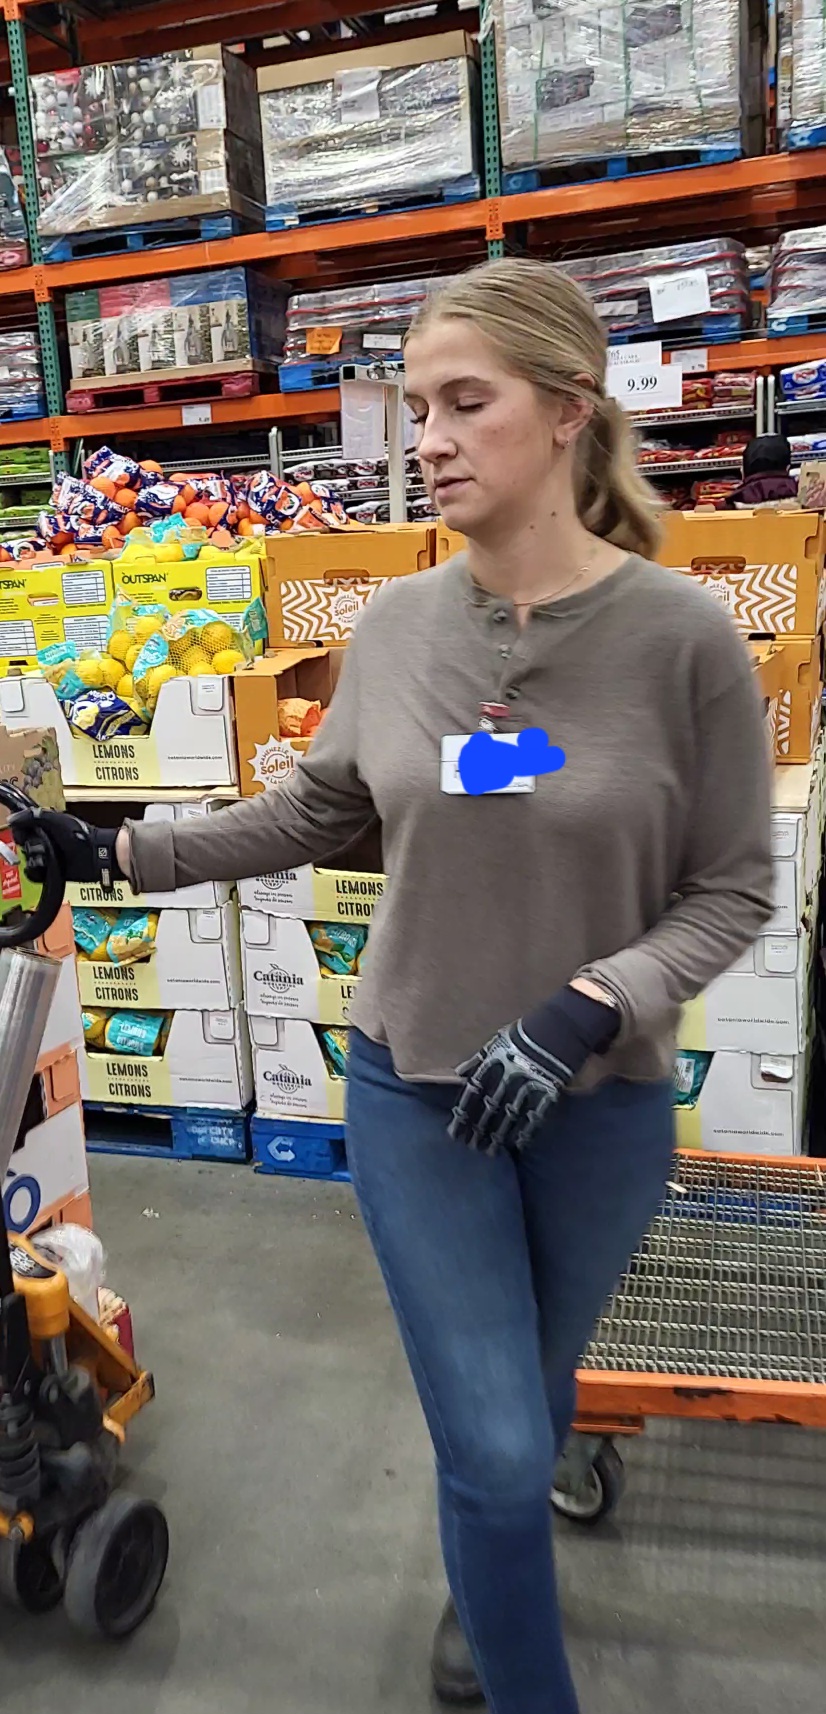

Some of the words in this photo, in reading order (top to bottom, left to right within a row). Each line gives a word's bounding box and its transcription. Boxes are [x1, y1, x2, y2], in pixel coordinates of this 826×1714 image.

[627, 376, 658, 392] 9.99
[0, 578, 26, 590] TSPAN
[122, 573, 168, 585] OUTSPAN
[334, 600, 359, 617] soleil
[92, 744, 136, 759] LEMONS
[260, 755, 294, 775] soleil
[95, 766, 140, 781] CITRONS
[335, 879, 384, 897] LEMONS
[337, 901, 375, 917] CITRO
[92, 966, 135, 981] LEMONS
[253, 970, 304, 986] Catania
[95, 986, 139, 1002] CITRONS
[106, 1062, 149, 1077] LEMONS
[262, 1070, 313, 1087] Catania
[108, 1083, 152, 1098] CITRONS
